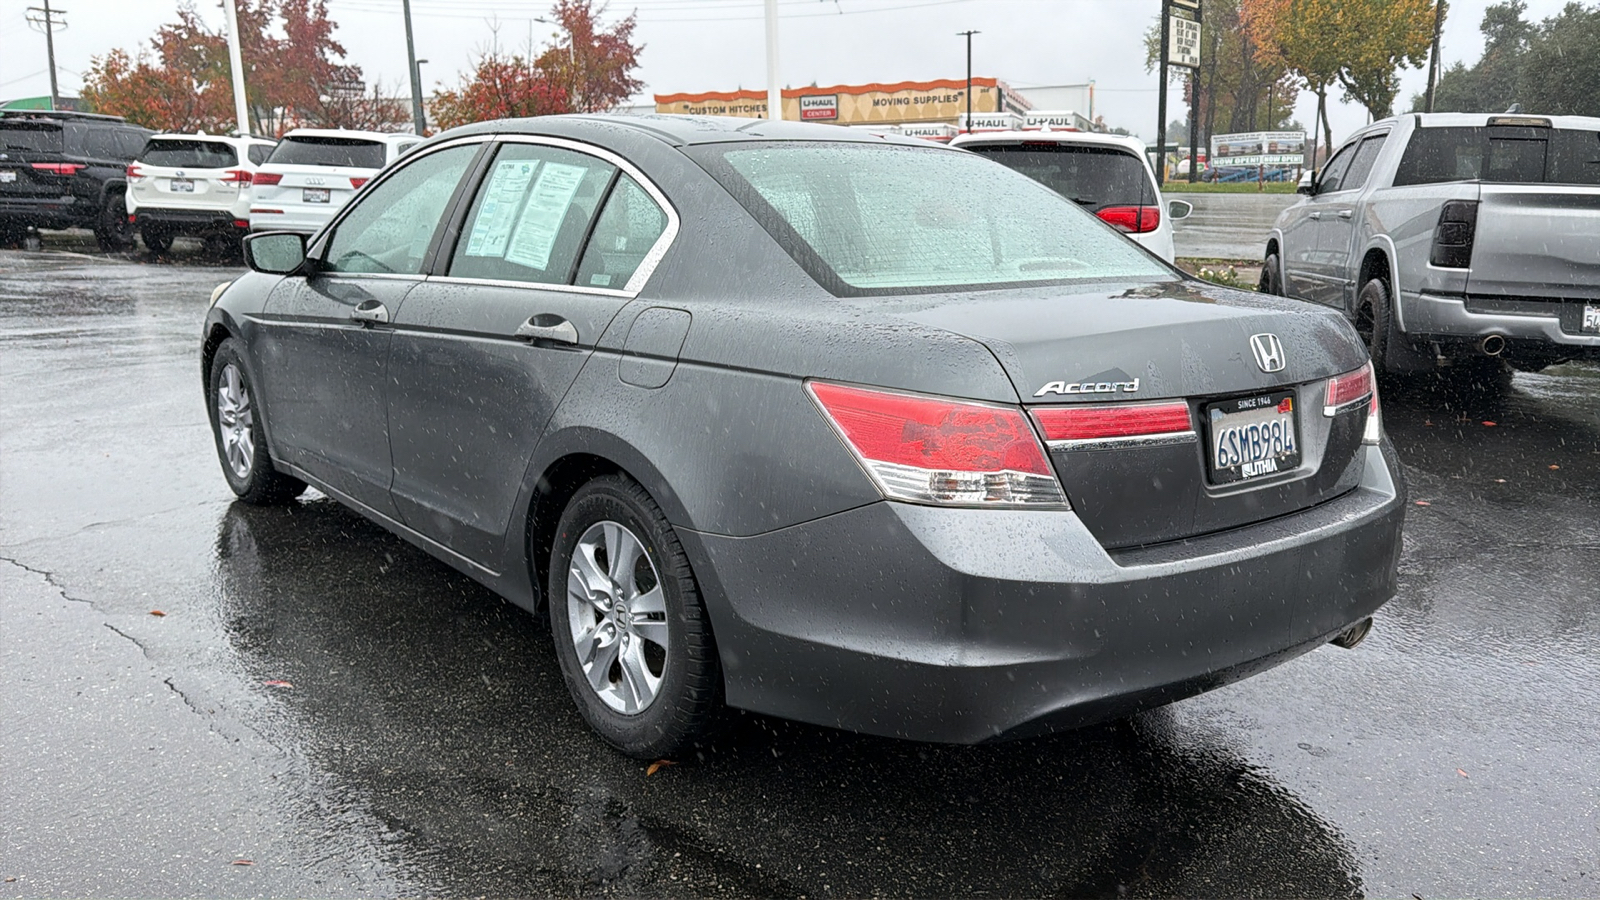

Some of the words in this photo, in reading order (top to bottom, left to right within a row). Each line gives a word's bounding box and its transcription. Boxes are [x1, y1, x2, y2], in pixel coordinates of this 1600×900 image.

[803, 98, 835, 107] U-HAUL
[873, 97, 909, 107] MOVING
[913, 94, 958, 105] SUPPLIES
[689, 106, 726, 115] CUSTOM
[729, 104, 768, 113] HITCHES
[806, 109, 832, 117] CENTER
[904, 129, 941, 137] U-HAUL
[1213, 157, 1232, 166] NOW
[1263, 155, 1280, 164] NOW
[1032, 378, 1140, 397] Accord
[1237, 398, 1257, 410] SINCE
[1257, 396, 1272, 407] 1946
[1216, 417, 1294, 468] 6SMB984
[1249, 457, 1278, 477] LITHIA
